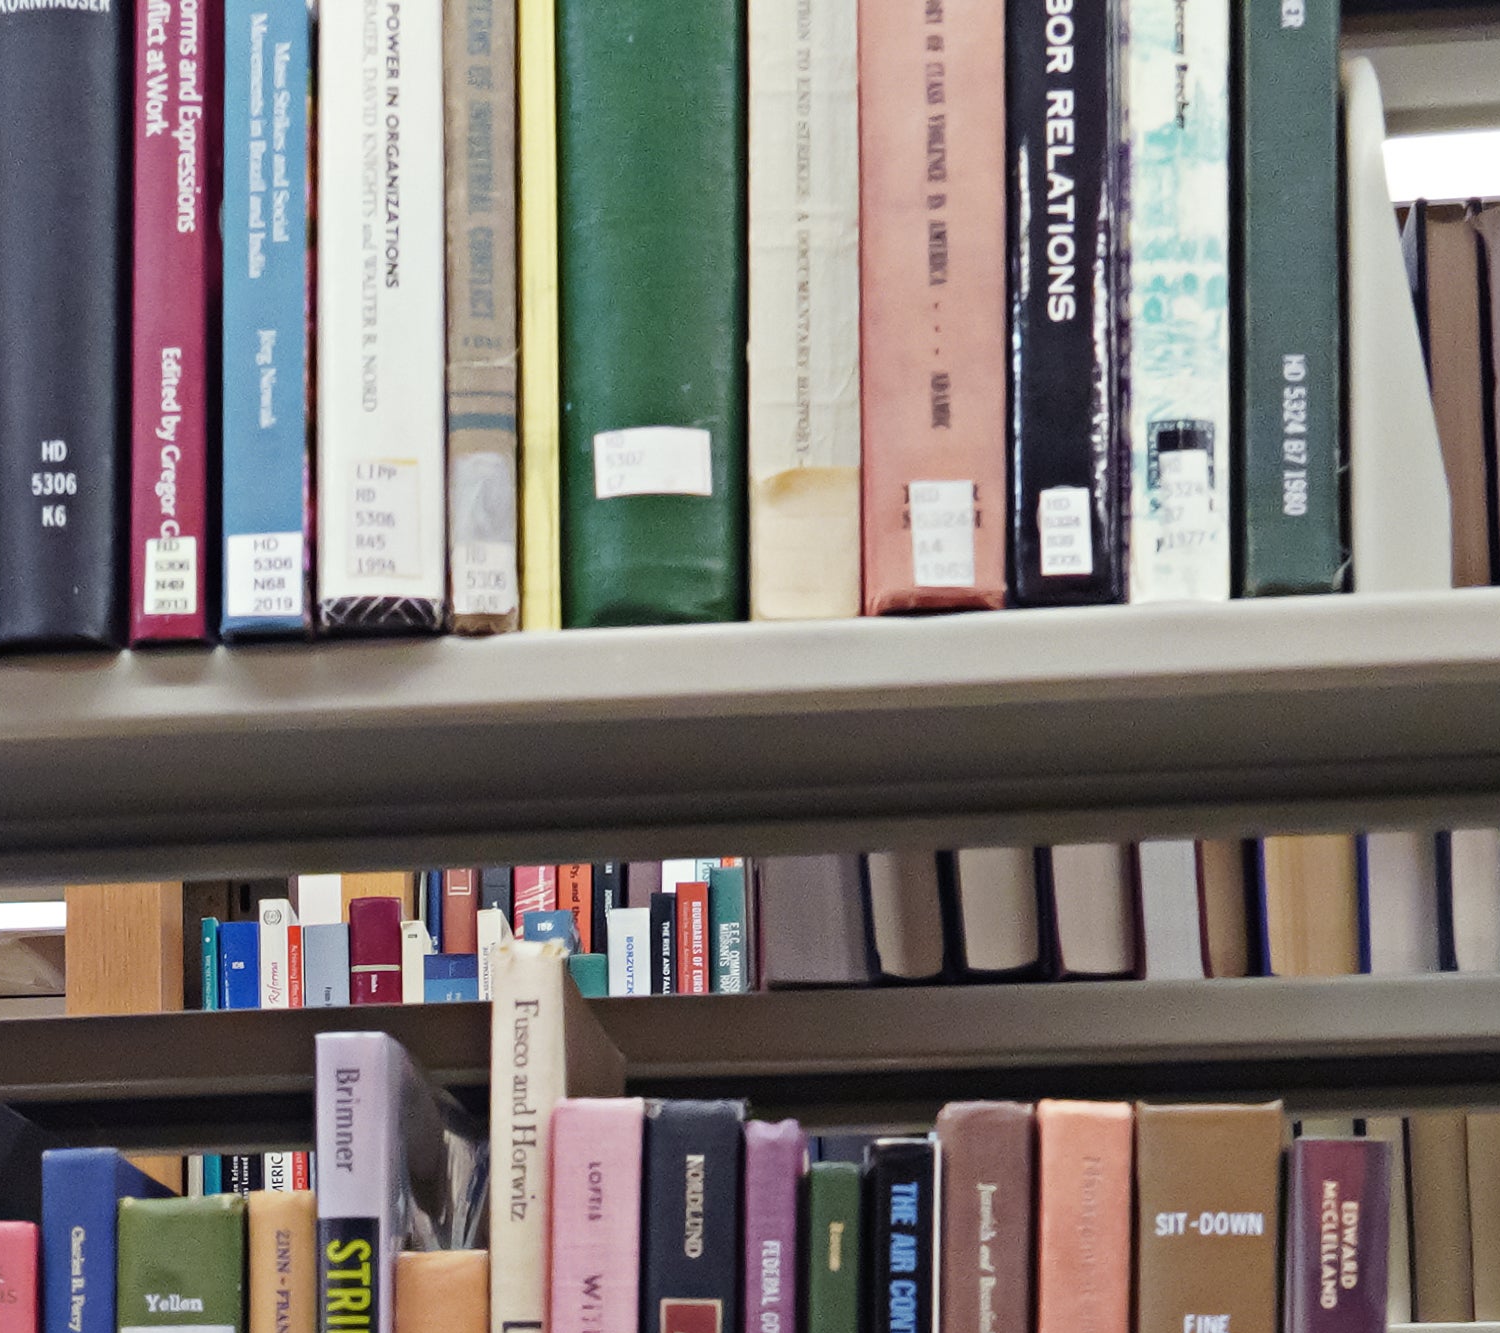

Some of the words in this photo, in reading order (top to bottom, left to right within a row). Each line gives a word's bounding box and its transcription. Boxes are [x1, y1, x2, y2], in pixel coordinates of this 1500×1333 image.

[386, 3, 399, 79] POWER
[386, 87, 399, 107] IN
[385, 110, 400, 288] ORGANIZATIONS
[1045, 90, 1075, 323] RELATIONS
[162, 347, 181, 412] Edited
[155, 415, 181, 441] by
[41, 440, 67, 462] HD
[31, 473, 77, 496] 5306
[155, 445, 181, 516] Gregor
[41, 505, 66, 527] K6
[253, 538, 279, 552] HD
[253, 557, 293, 571] 5306
[253, 577, 286, 591] N68
[513, 999, 539, 1067] Fusco
[511, 1073, 538, 1113] and
[335, 1067, 360, 1174] Brimner
[510, 1123, 538, 1222] Horwitz
[889, 1182, 918, 1224] THE
[1155, 1212, 1264, 1236] SIT-DOWN
[889, 1233, 918, 1272] AIR
[145, 1294, 204, 1313] Yellen
